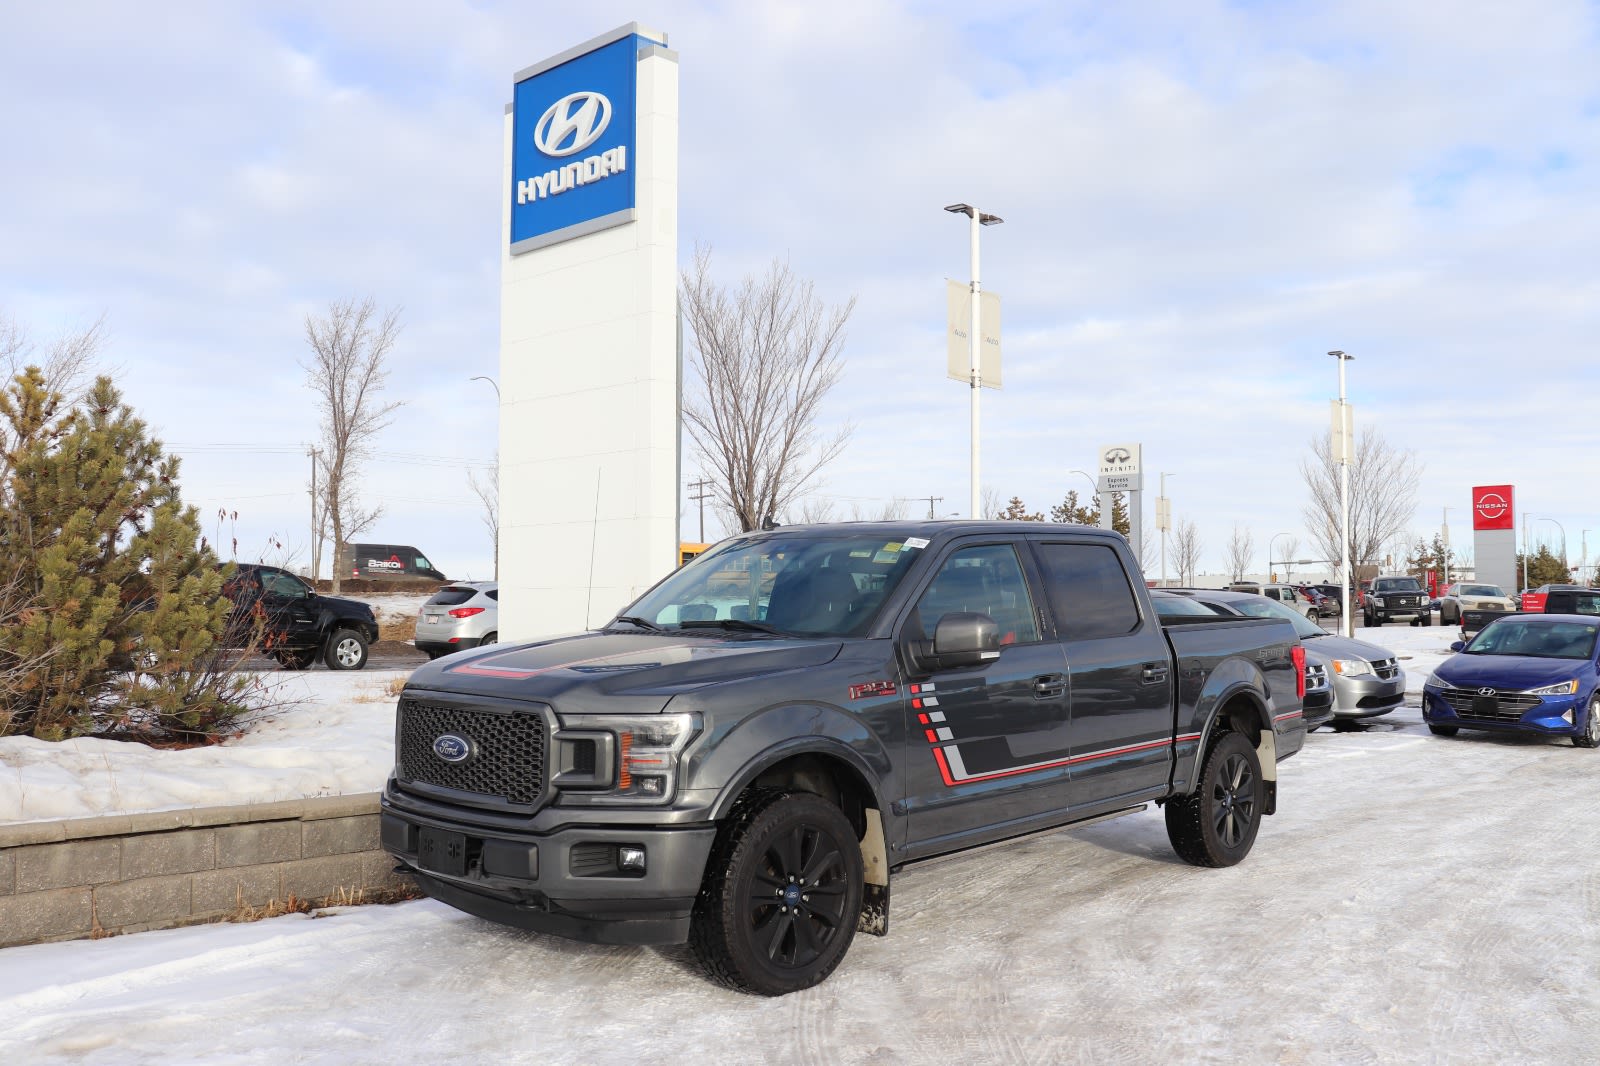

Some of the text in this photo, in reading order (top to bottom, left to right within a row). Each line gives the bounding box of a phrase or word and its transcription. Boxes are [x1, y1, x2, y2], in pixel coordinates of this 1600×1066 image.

[517, 145, 626, 205] HYUNDAI
[1100, 465, 1136, 473] INFINITI
[439, 739, 460, 756] Ford
